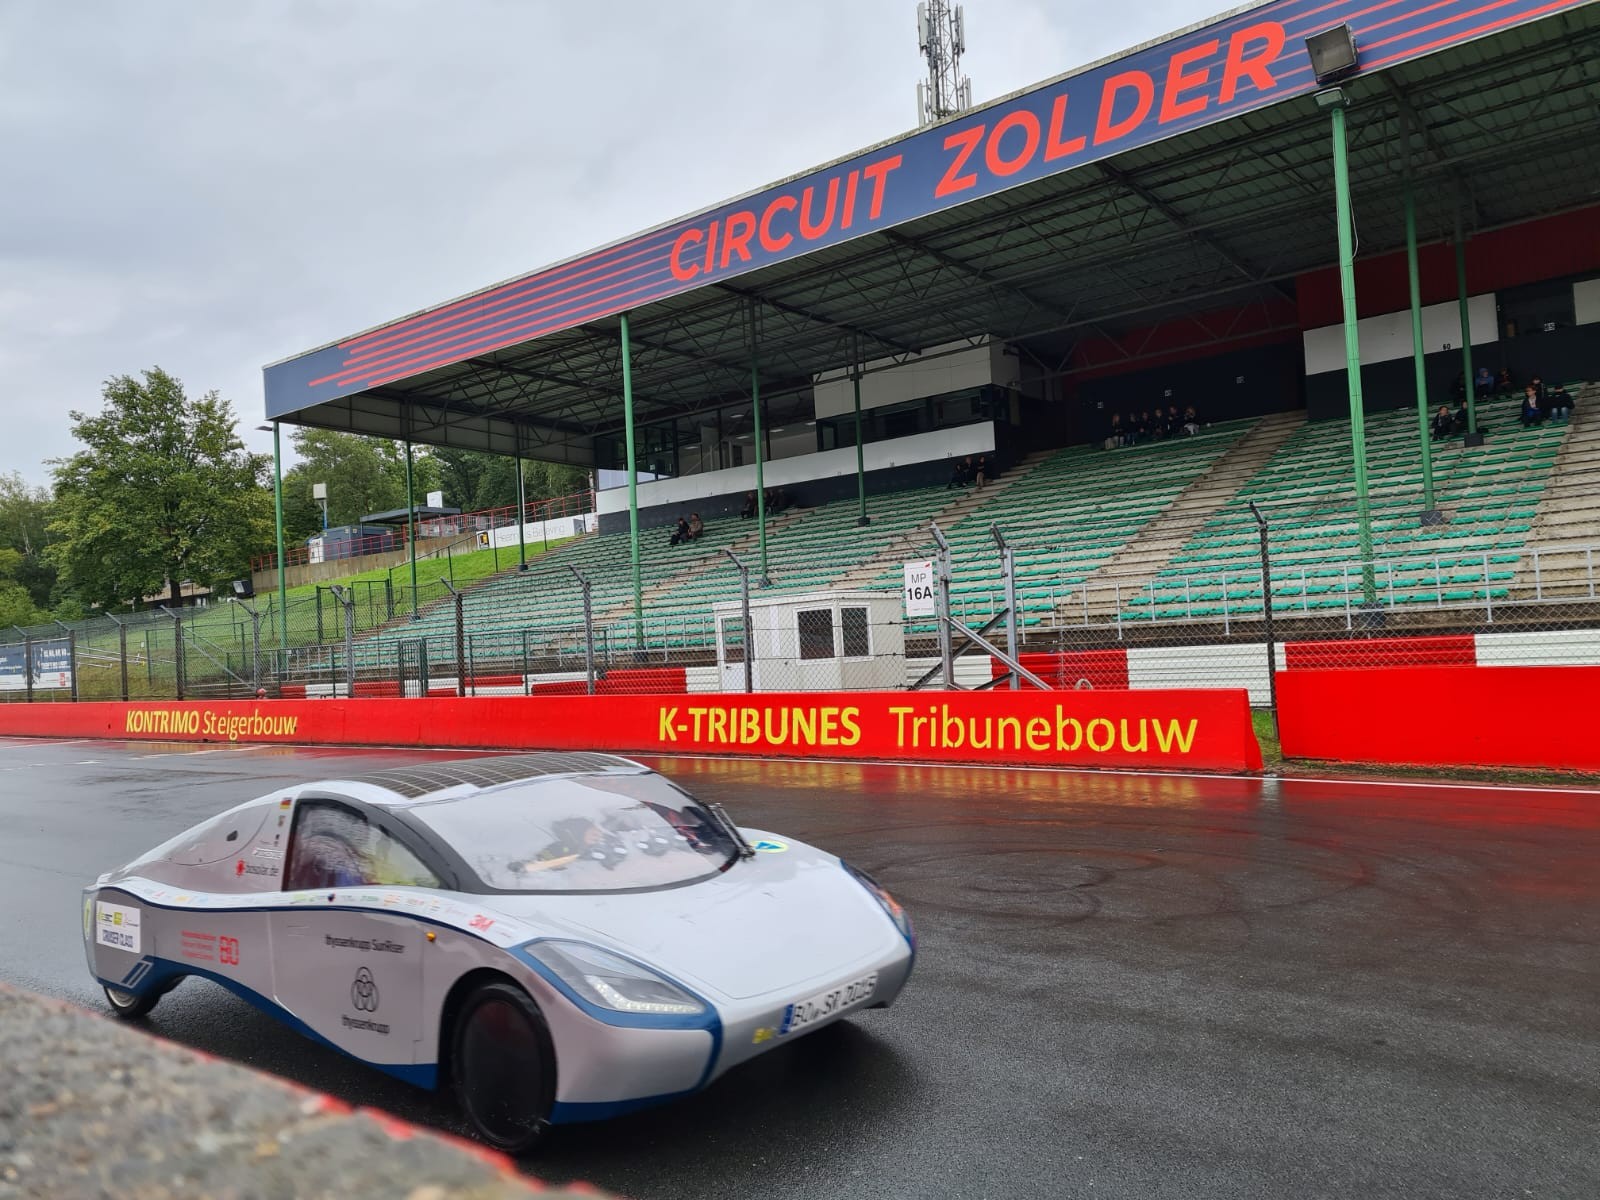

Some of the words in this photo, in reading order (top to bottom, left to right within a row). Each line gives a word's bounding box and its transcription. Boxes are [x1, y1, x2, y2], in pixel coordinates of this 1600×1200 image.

[670, 155, 903, 281] CIRCUIT
[934, 21, 1286, 199] ZOLDER
[907, 586, 933, 600] 16A
[911, 573, 927, 584] MP
[126, 710, 200, 734] KONTRIMO
[202, 709, 298, 740] Steigerbouw
[658, 706, 861, 747] K-TRIBUNES
[888, 704, 1198, 754] Tribunebouw
